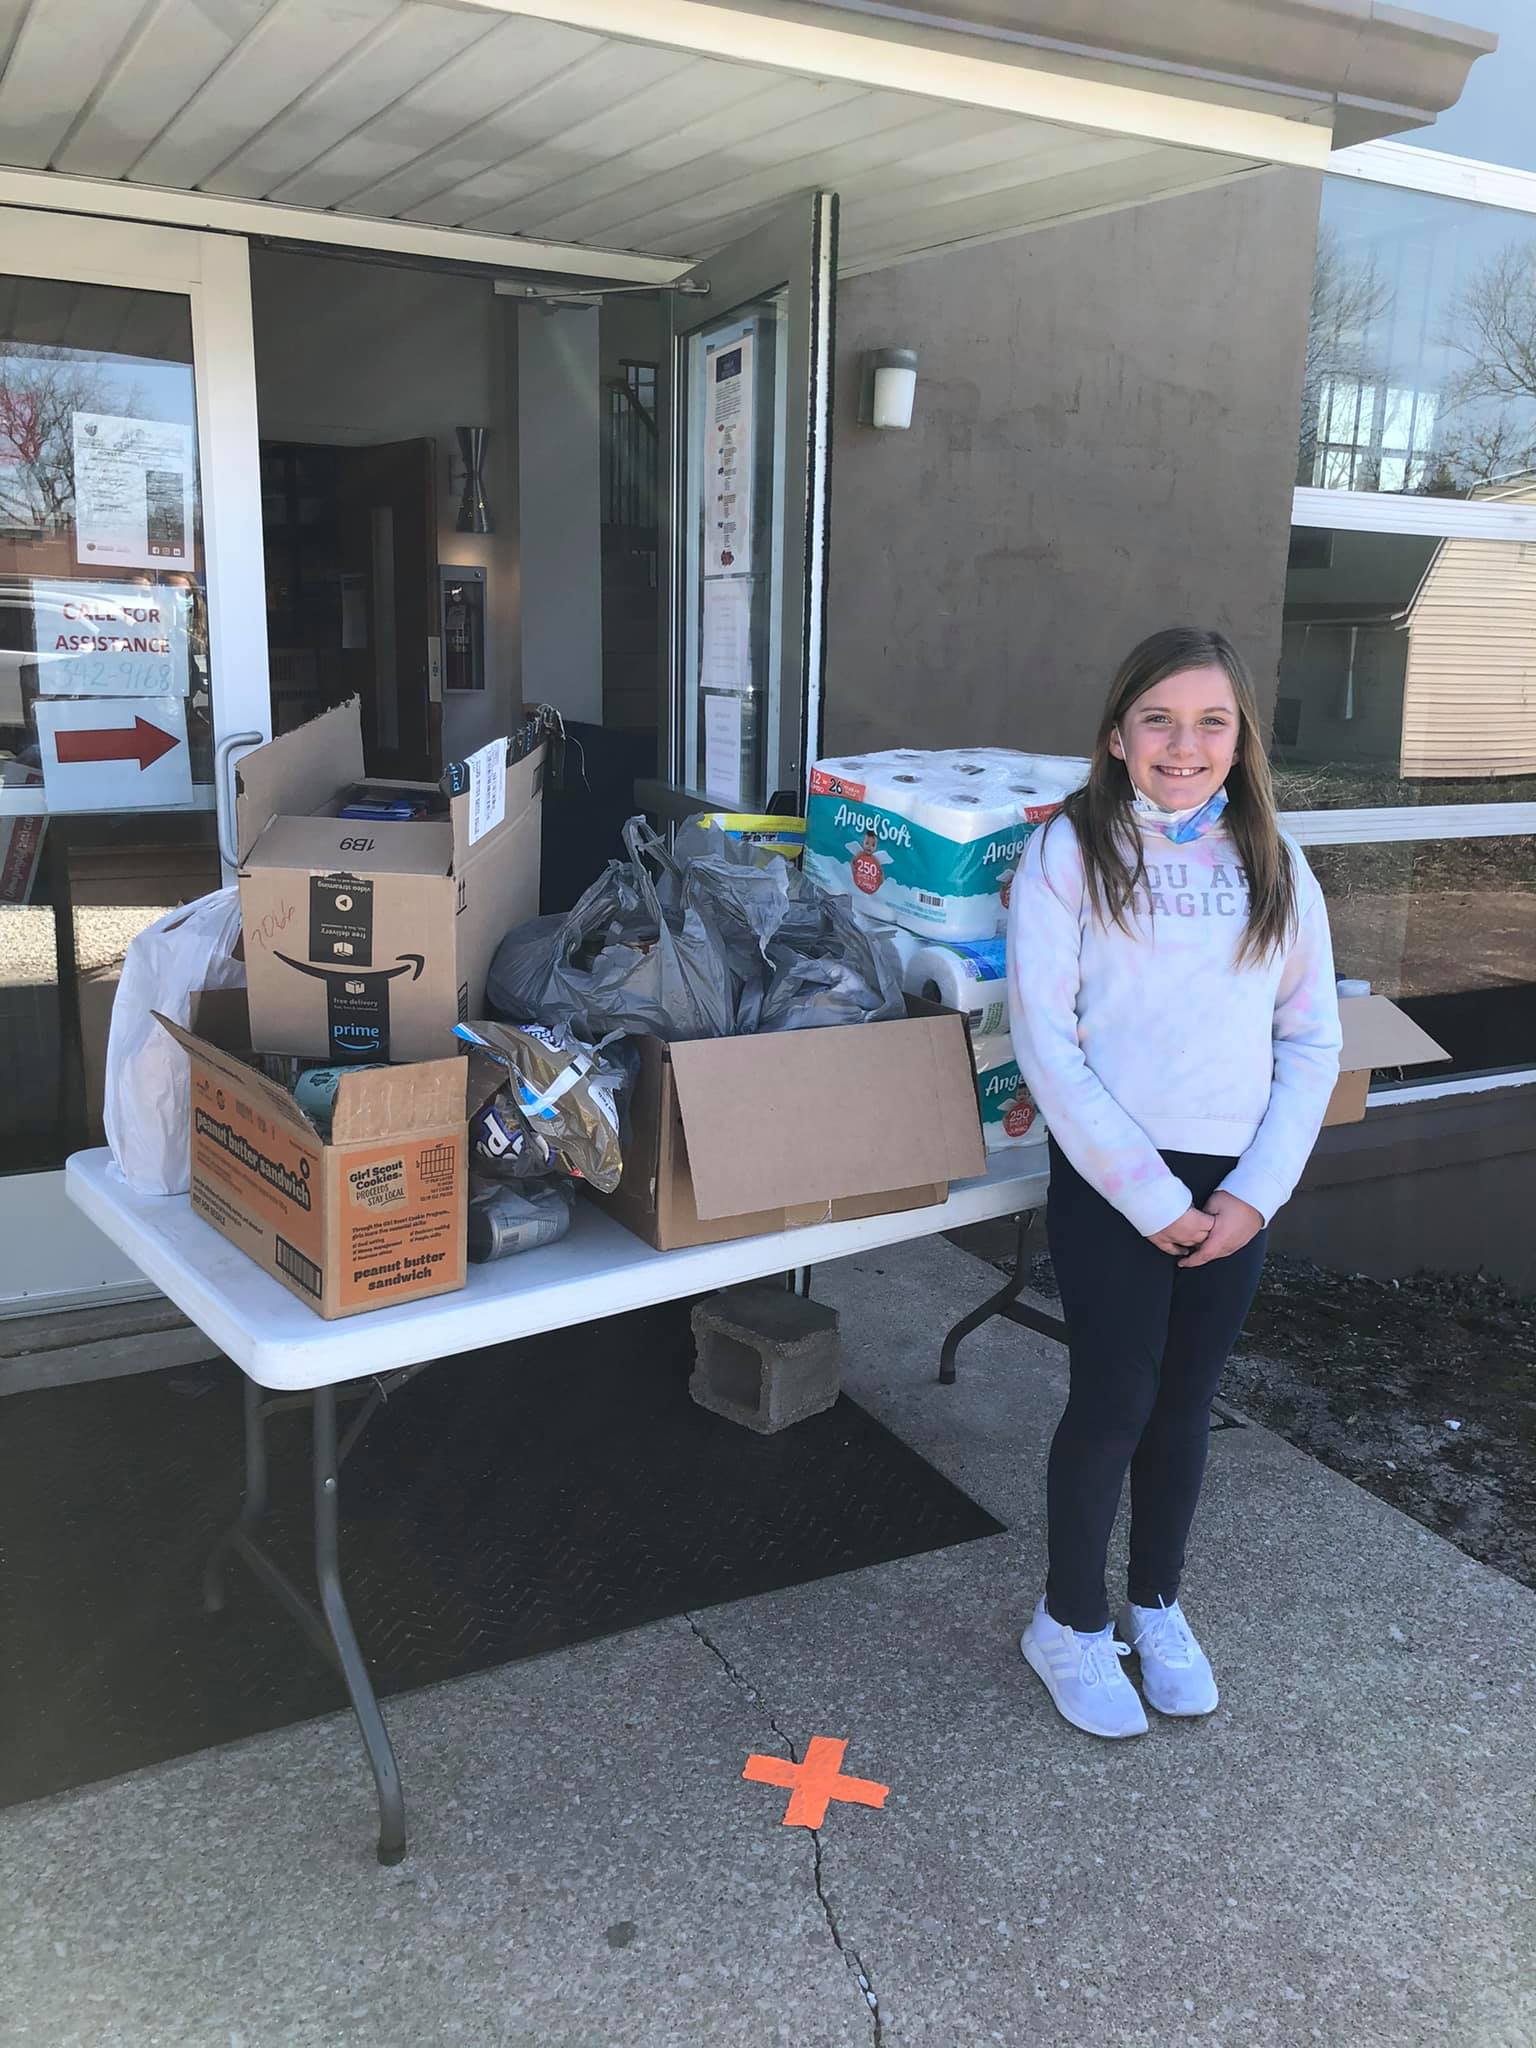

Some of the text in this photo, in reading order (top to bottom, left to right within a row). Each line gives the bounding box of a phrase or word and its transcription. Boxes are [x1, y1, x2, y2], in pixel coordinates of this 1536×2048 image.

[123, 607, 160, 623] FOR
[55, 634, 171, 653] ASSISTANCE
[829, 778, 843, 794] 26
[834, 803, 912, 848] Angel Soft
[339, 837, 376, 852] 1B9
[857, 859, 878, 877] 250
[333, 1023, 379, 1038] prime
[985, 1072, 1025, 1096] Ange
[1010, 1108, 1030, 1121] 250
[196, 1109, 229, 1148] peanut
[228, 1129, 258, 1167] butter
[259, 1158, 310, 1209] sandwich
[349, 1160, 403, 1183] Girl Scout
[356, 1183, 389, 1201] PROCEEDS
[368, 1193, 383, 1207] STAY
[385, 1188, 405, 1200] LOCAL
[354, 1252, 446, 1282] peanut butter
[368, 1266, 432, 1291] sandwich
